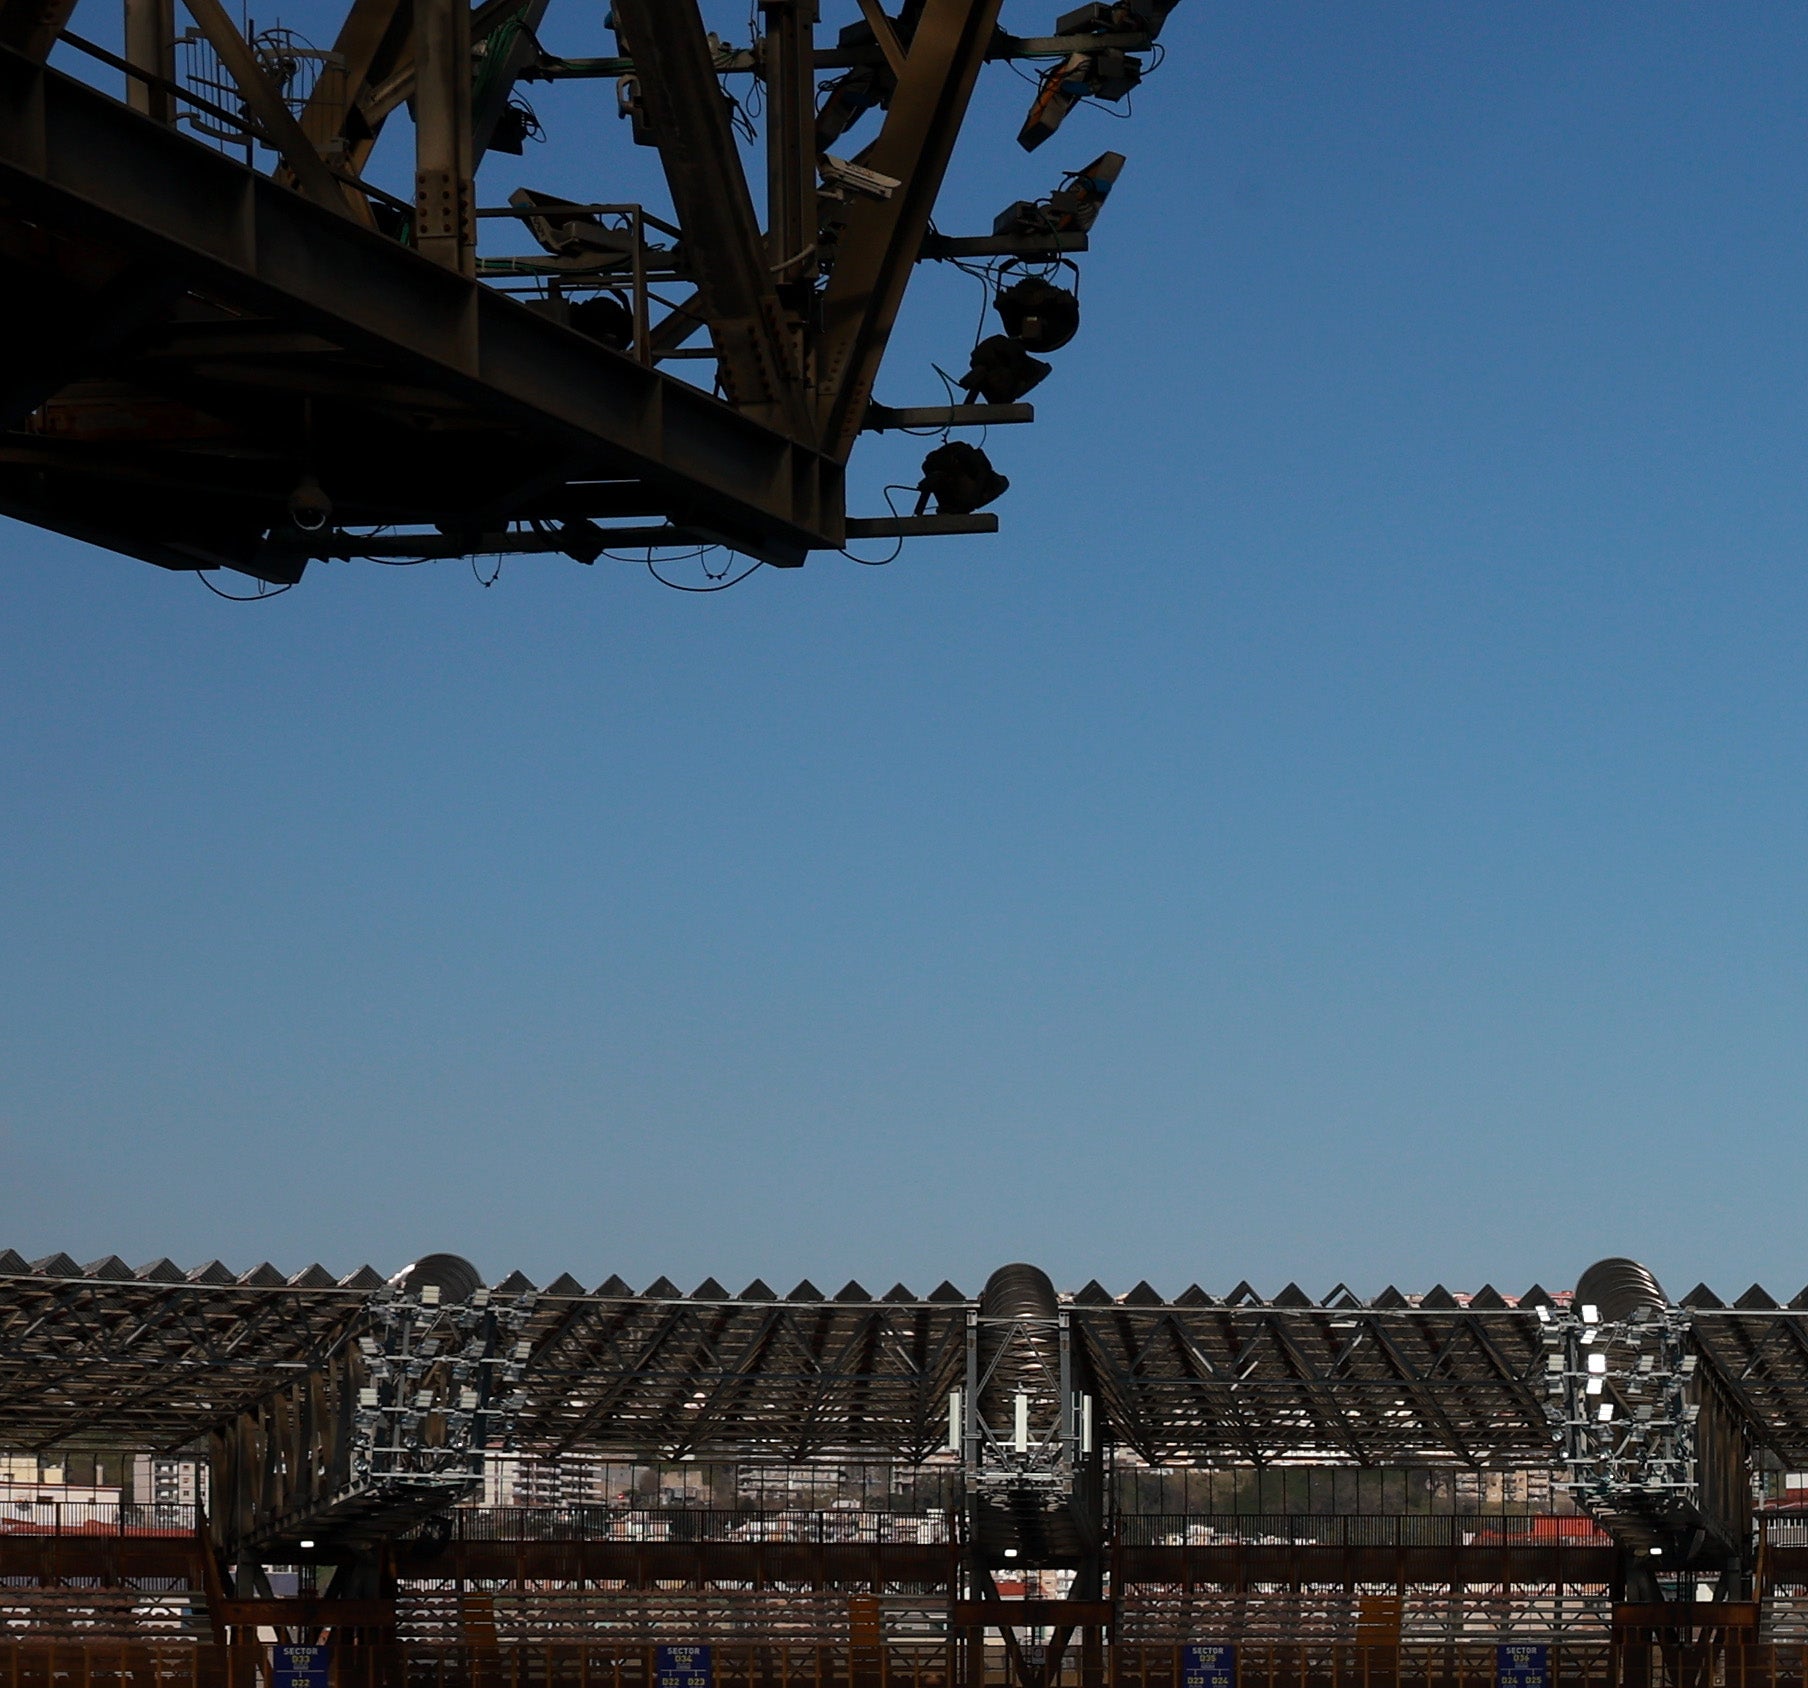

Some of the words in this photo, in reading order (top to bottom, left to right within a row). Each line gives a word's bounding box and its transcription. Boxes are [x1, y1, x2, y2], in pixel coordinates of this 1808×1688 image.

[283, 1647, 319, 1656] SECTOR
[667, 1647, 700, 1655] SECTOR
[1192, 1647, 1224, 1655] SECTOR
[1506, 1647, 1538, 1655] SECTOR
